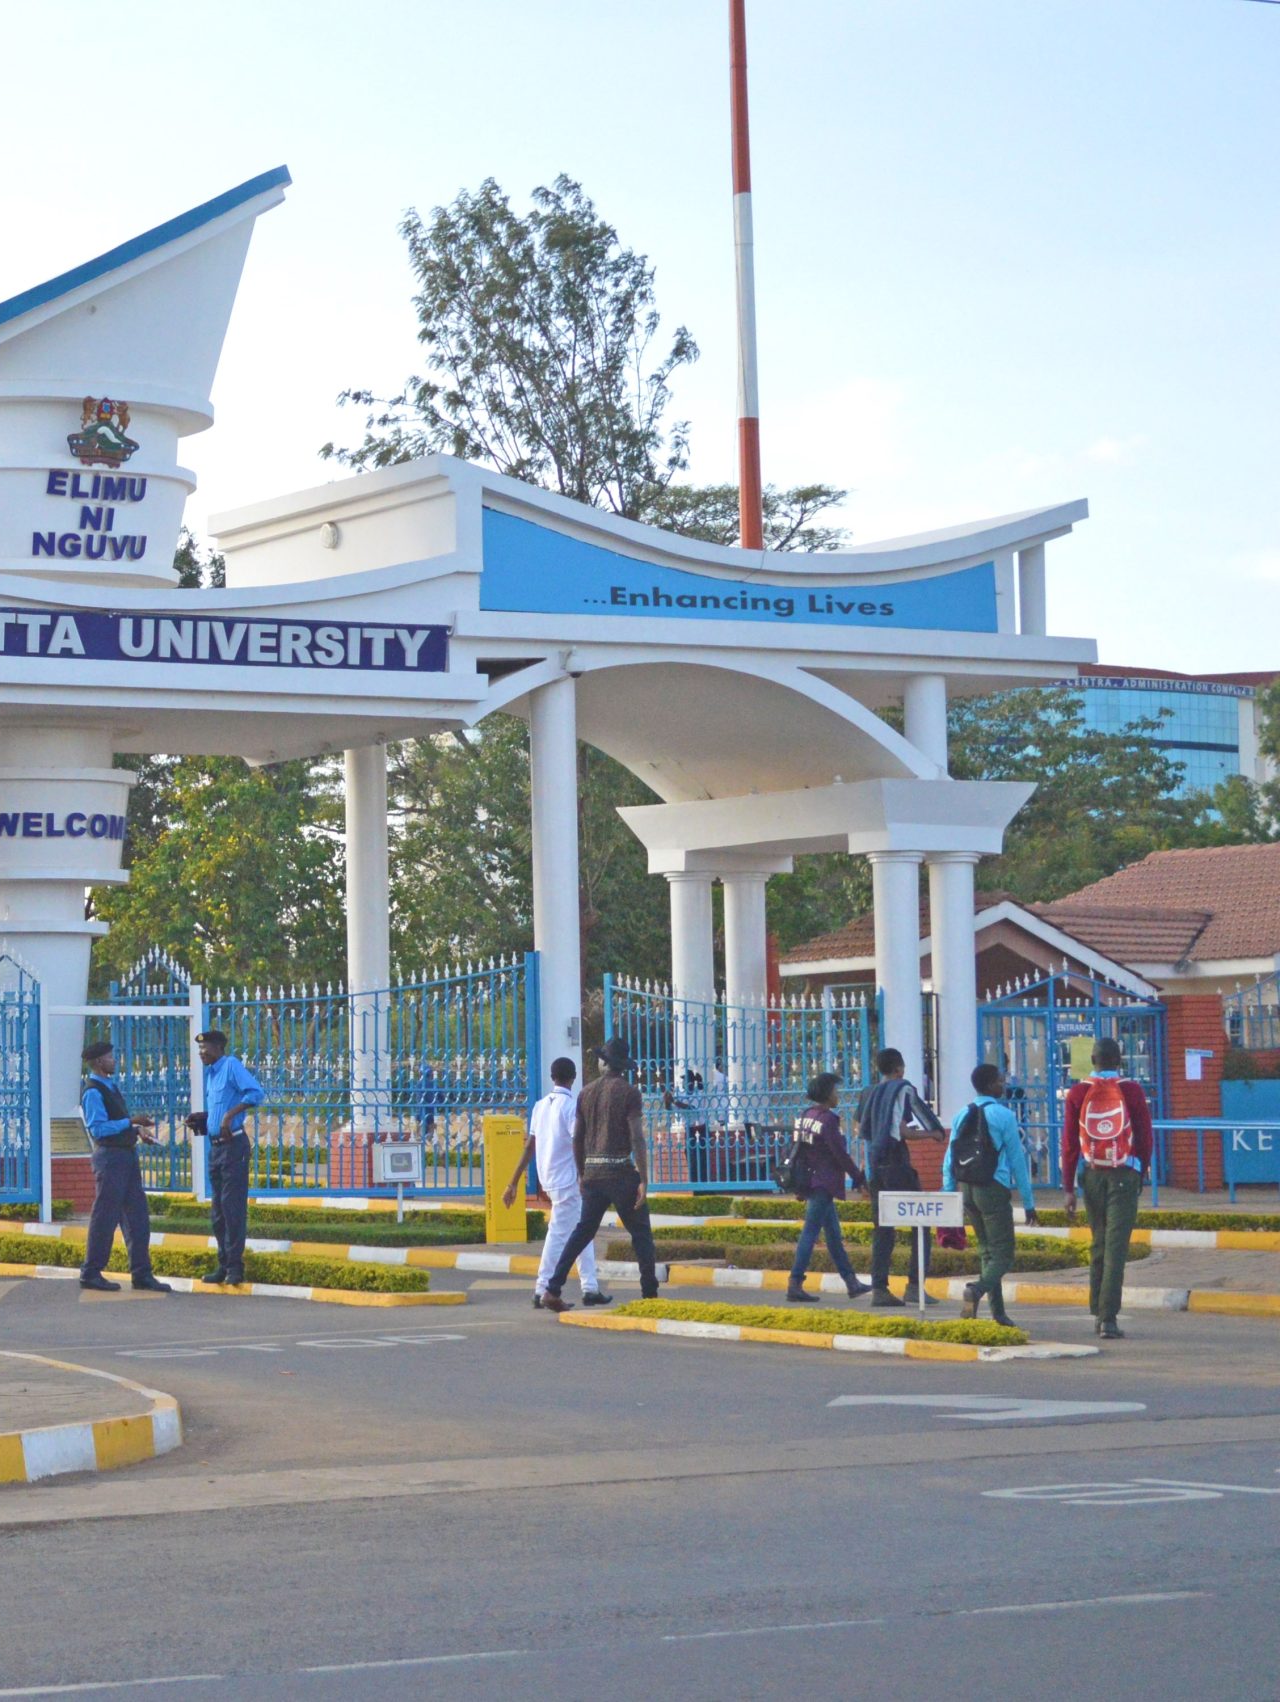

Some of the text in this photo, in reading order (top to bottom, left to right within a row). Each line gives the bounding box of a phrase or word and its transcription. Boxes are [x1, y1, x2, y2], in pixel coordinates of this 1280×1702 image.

[46, 470, 147, 502] ELIMU
[79, 505, 115, 532] NI
[32, 531, 147, 561] NGUVU
[808, 594, 895, 617] Lives
[119, 617, 430, 667] UNIVERSITY
[1066, 678, 1119, 688] CENTRA
[1122, 678, 1208, 692] ADMINISTRATION
[1056, 1023, 1094, 1032] ENTRANCE
[897, 1201, 944, 1217] STAFF
[114, 1334, 468, 1358] STOP
